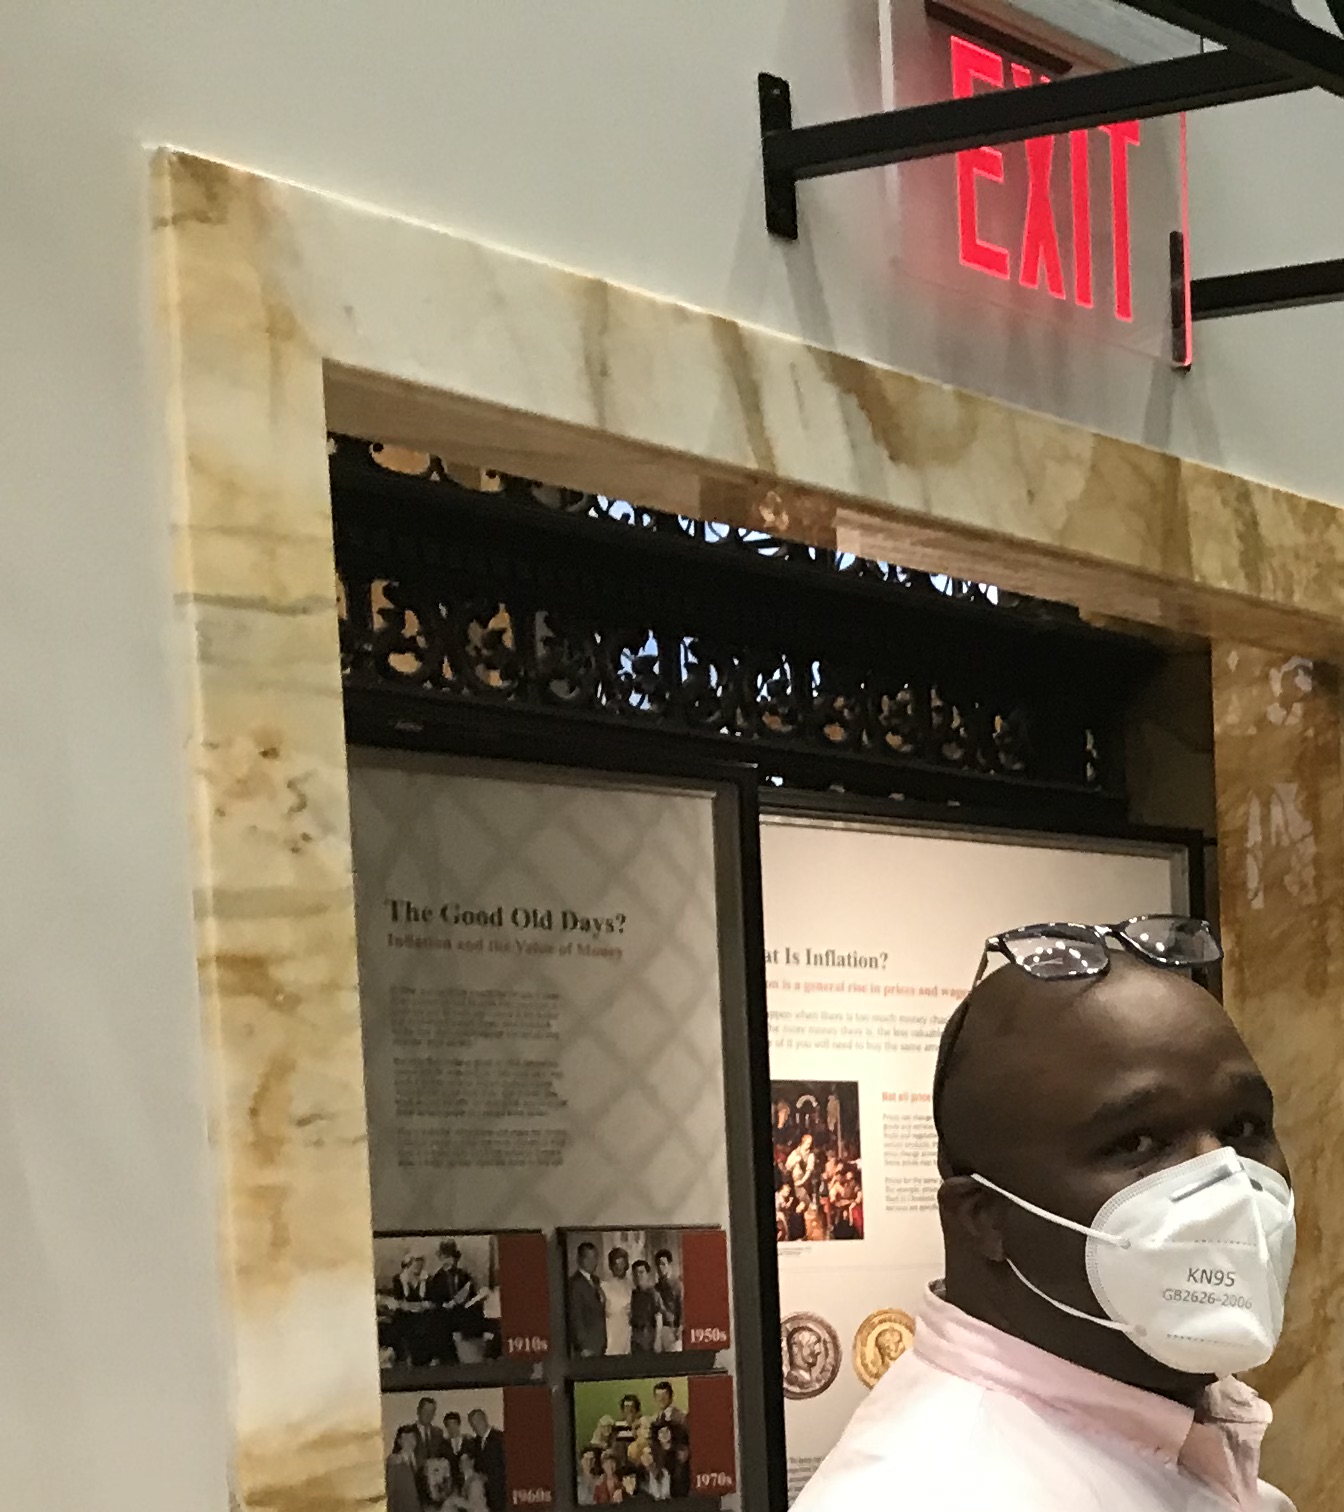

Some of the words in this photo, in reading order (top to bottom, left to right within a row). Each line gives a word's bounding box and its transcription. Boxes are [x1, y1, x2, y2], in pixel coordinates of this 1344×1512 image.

[951, 35, 1140, 322] EXIT
[385, 899, 433, 924] The
[439, 902, 503, 928] Good
[511, 906, 553, 931] Old
[561, 909, 627, 940] Days?
[785, 947, 800, 966] Is
[805, 948, 889, 970] Inflation?
[918, 984, 938, 997] and
[1187, 1267, 1236, 1288] KN95
[507, 1336, 549, 1353] 1910s
[689, 1327, 728, 1344] 1950s
[695, 1471, 734, 1488] 1970s
